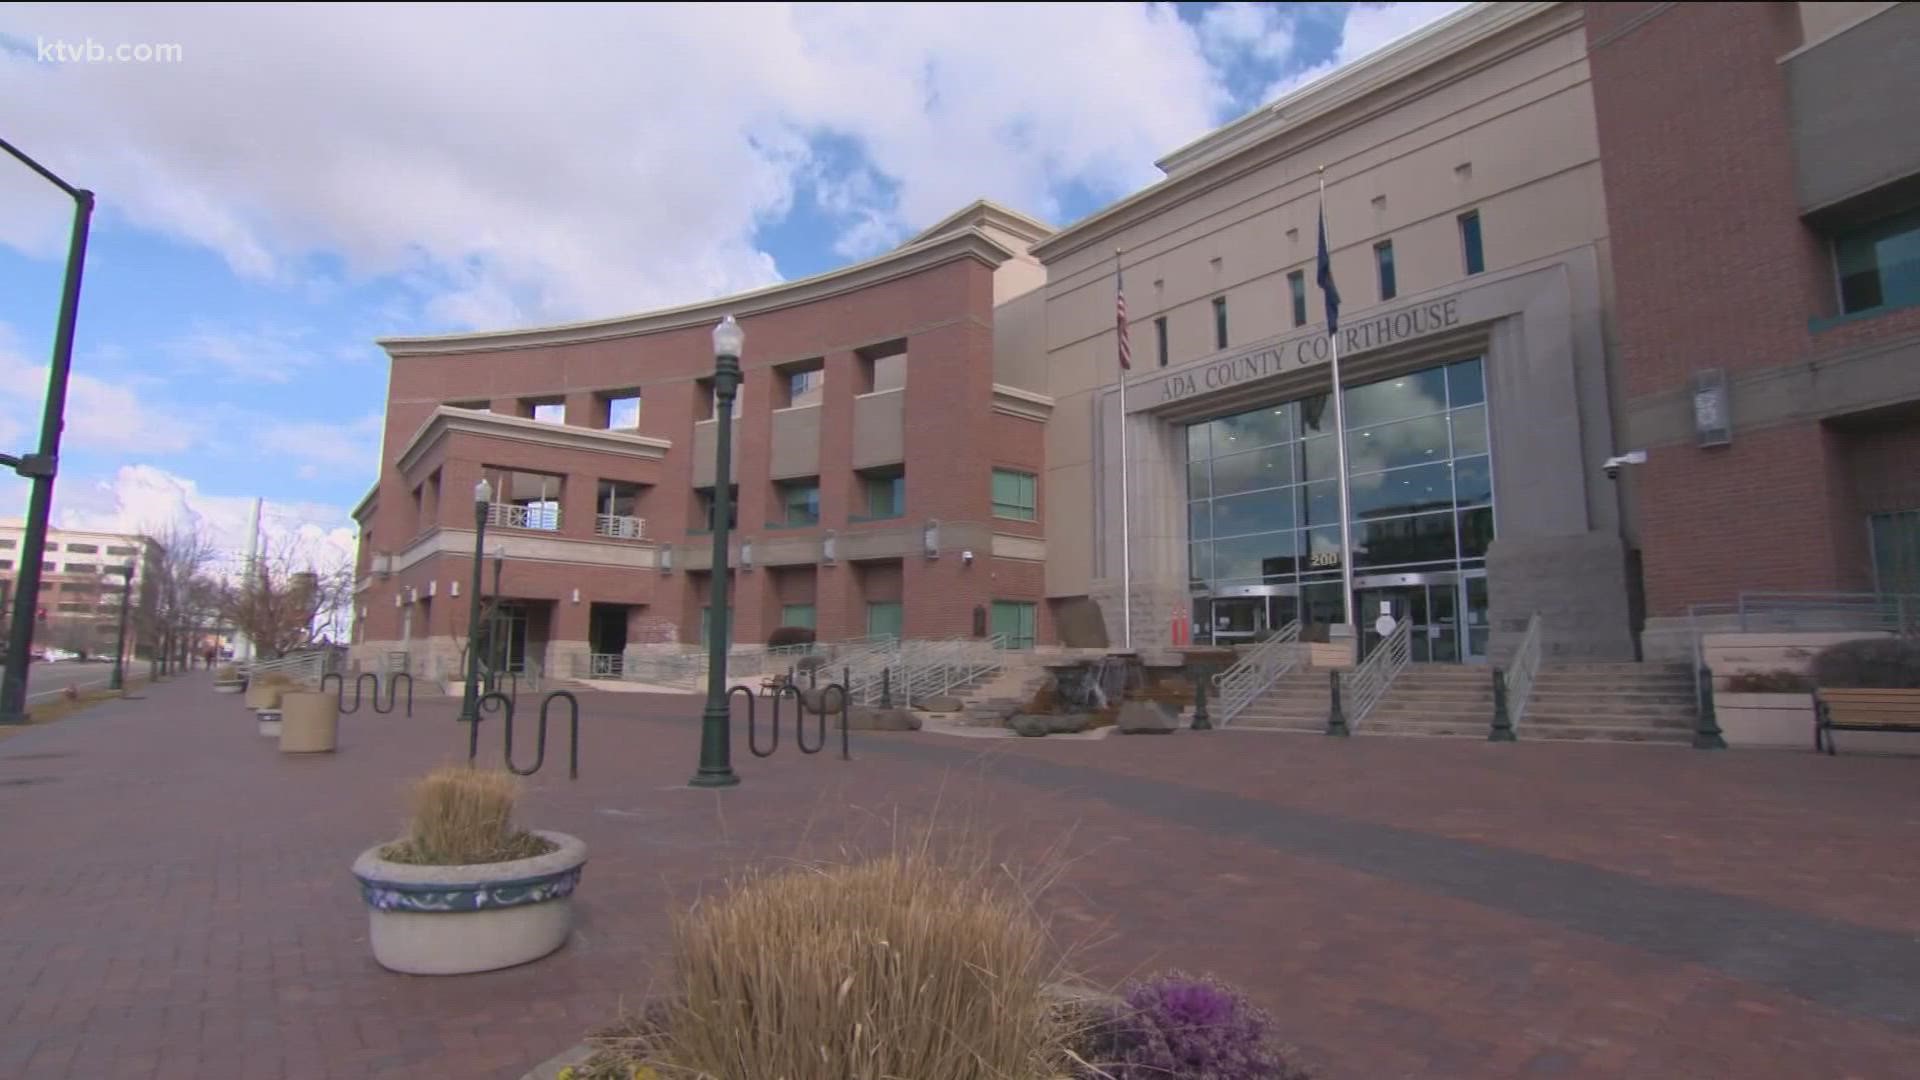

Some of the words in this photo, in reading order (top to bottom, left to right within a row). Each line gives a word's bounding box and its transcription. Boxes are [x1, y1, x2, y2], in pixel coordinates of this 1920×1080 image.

[1161, 373, 1197, 401] ADA
[1205, 346, 1286, 389] COUNTY
[1311, 552, 1338, 566] 200
